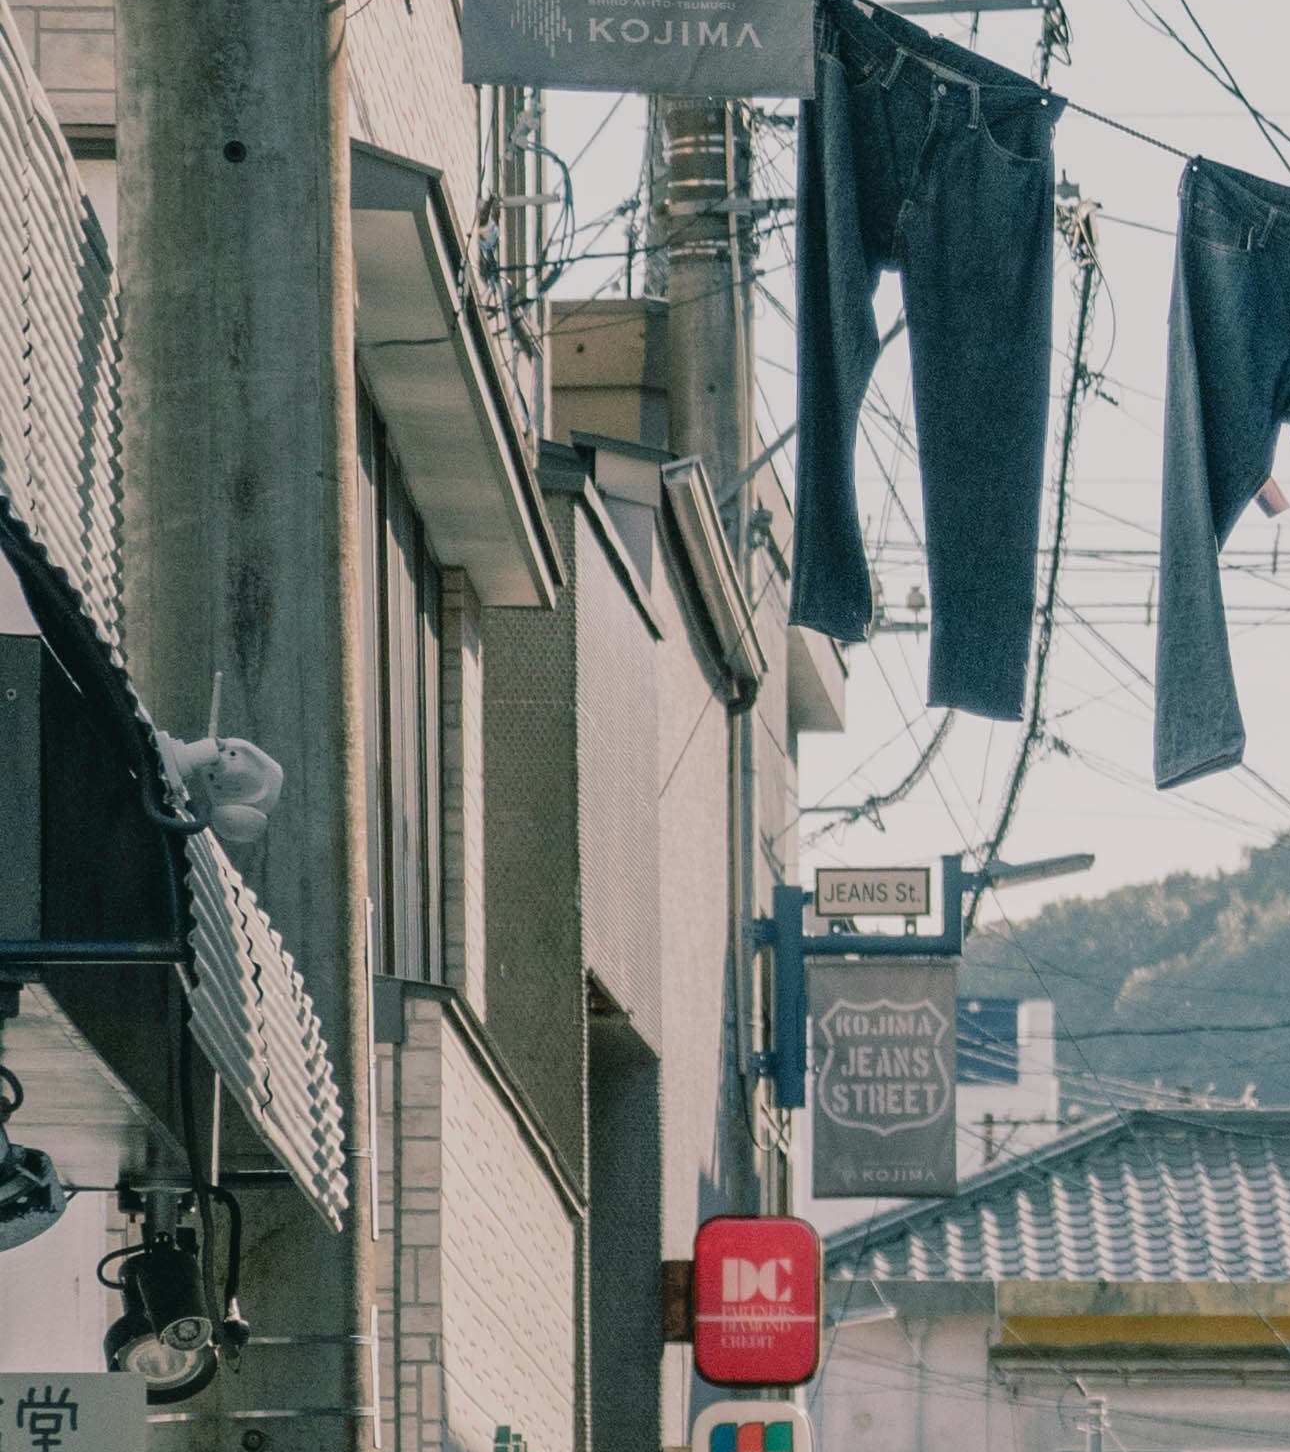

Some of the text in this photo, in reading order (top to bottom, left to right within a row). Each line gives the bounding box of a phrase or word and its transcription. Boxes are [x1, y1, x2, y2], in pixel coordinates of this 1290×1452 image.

[588, 17, 764, 48] KOJIMA
[824, 882, 921, 903] JEANS St.
[835, 1014, 932, 1037] KOJIMA
[840, 1047, 931, 1077] JEANS
[831, 1083, 940, 1114] STREET
[721, 1258, 792, 1303] DC
[720, 1334, 775, 1349] CREDIT
